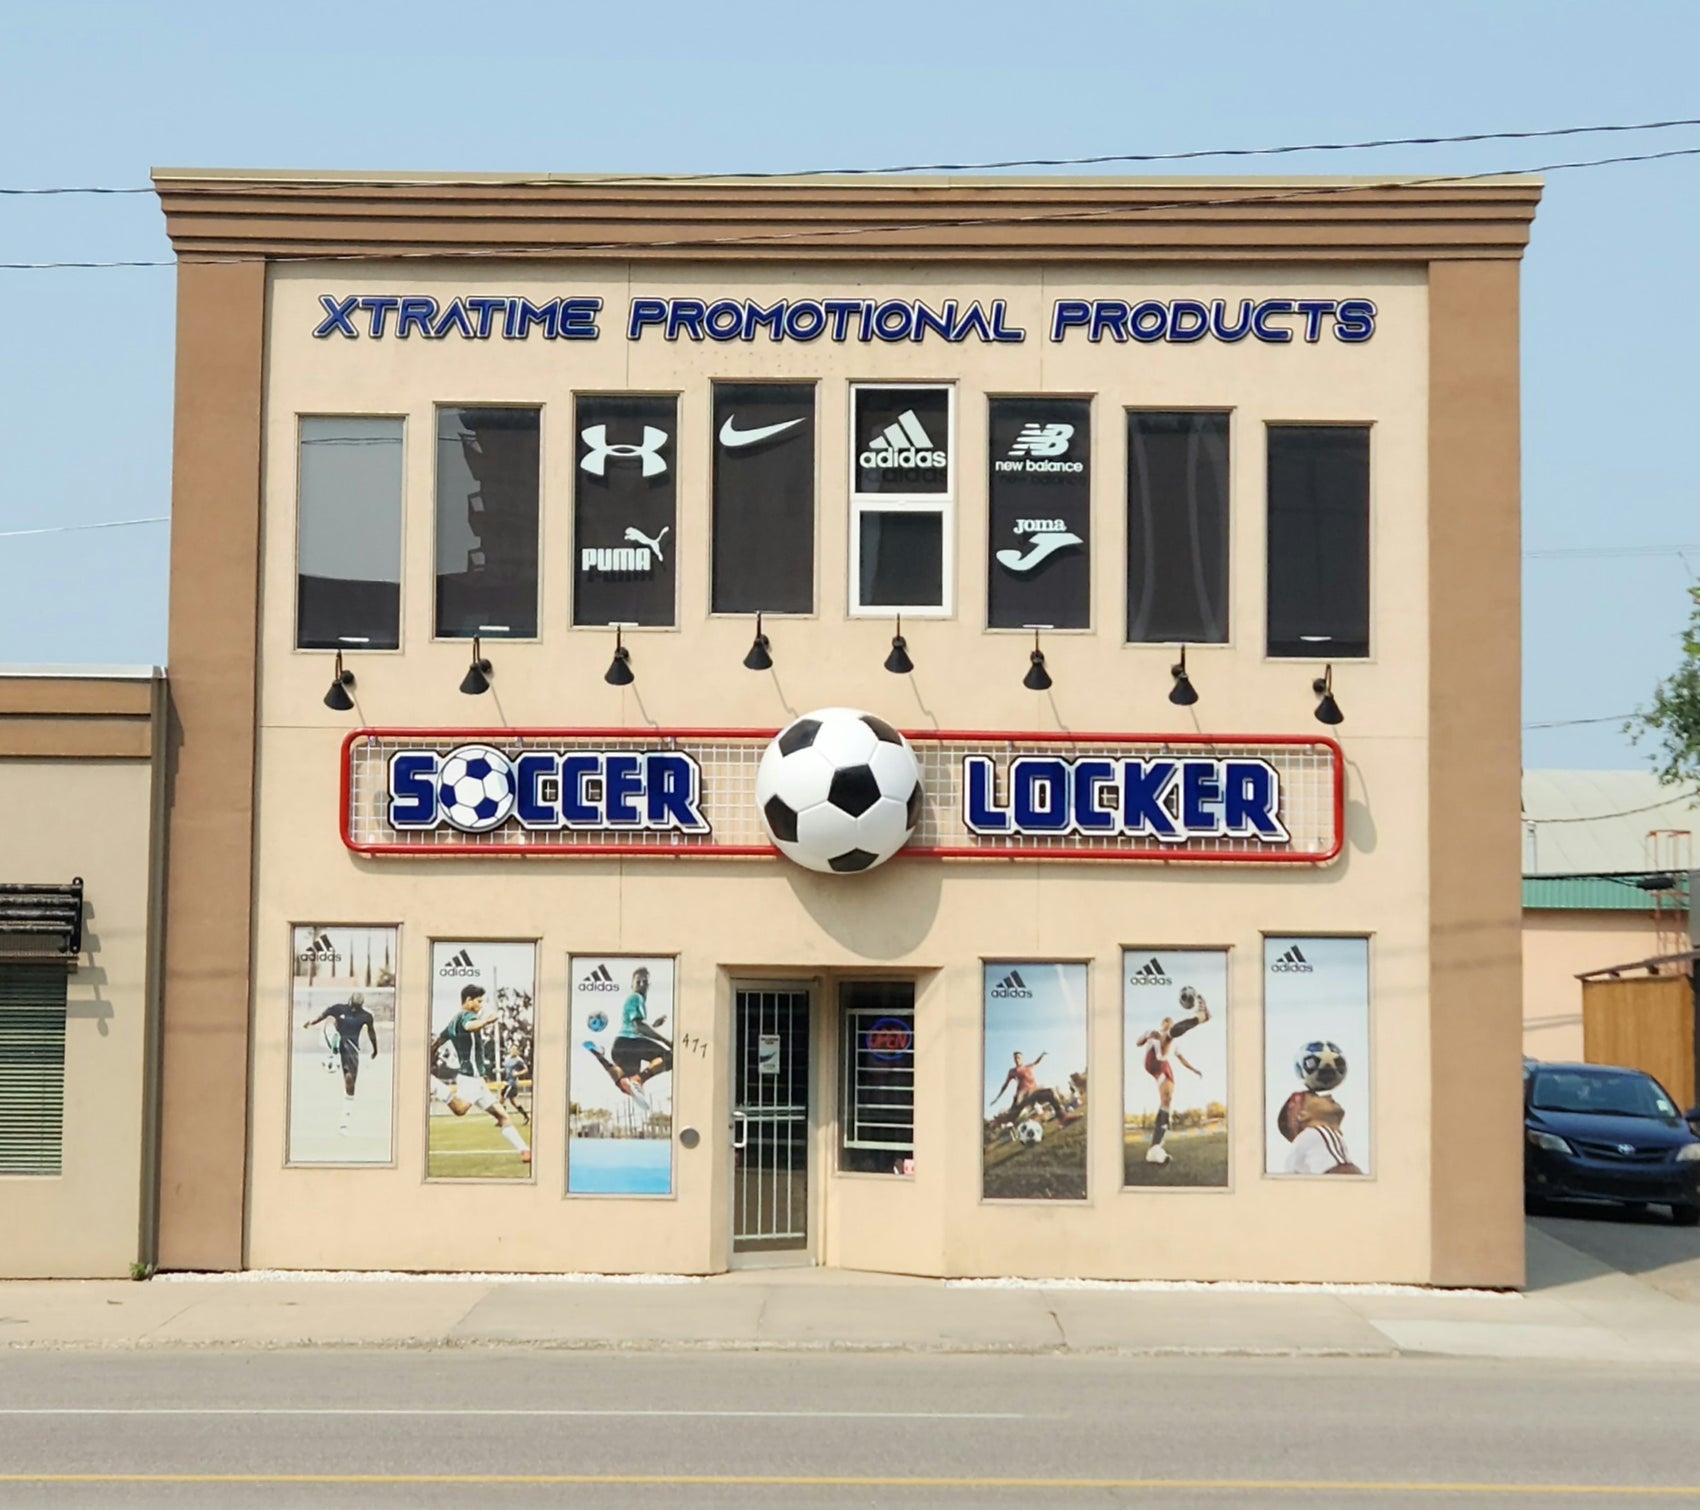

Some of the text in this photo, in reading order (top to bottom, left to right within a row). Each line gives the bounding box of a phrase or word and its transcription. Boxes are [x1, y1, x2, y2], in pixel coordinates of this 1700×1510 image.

[313, 294, 1377, 343] XTRATIME PROMOTIONAL PRODUCTS
[859, 446, 947, 468] adidas
[995, 459, 1084, 472] new balance
[581, 547, 652, 572] PUMA
[388, 744, 1291, 844] SOCCER LOCKER
[300, 951, 342, 962] adidas
[439, 966, 481, 977] adidas
[1271, 962, 1313, 973] adidas
[1130, 974, 1172, 986] adidas
[578, 981, 620, 992] adidas
[991, 987, 1033, 999] adidas
[682, 1032, 708, 1059] 477
